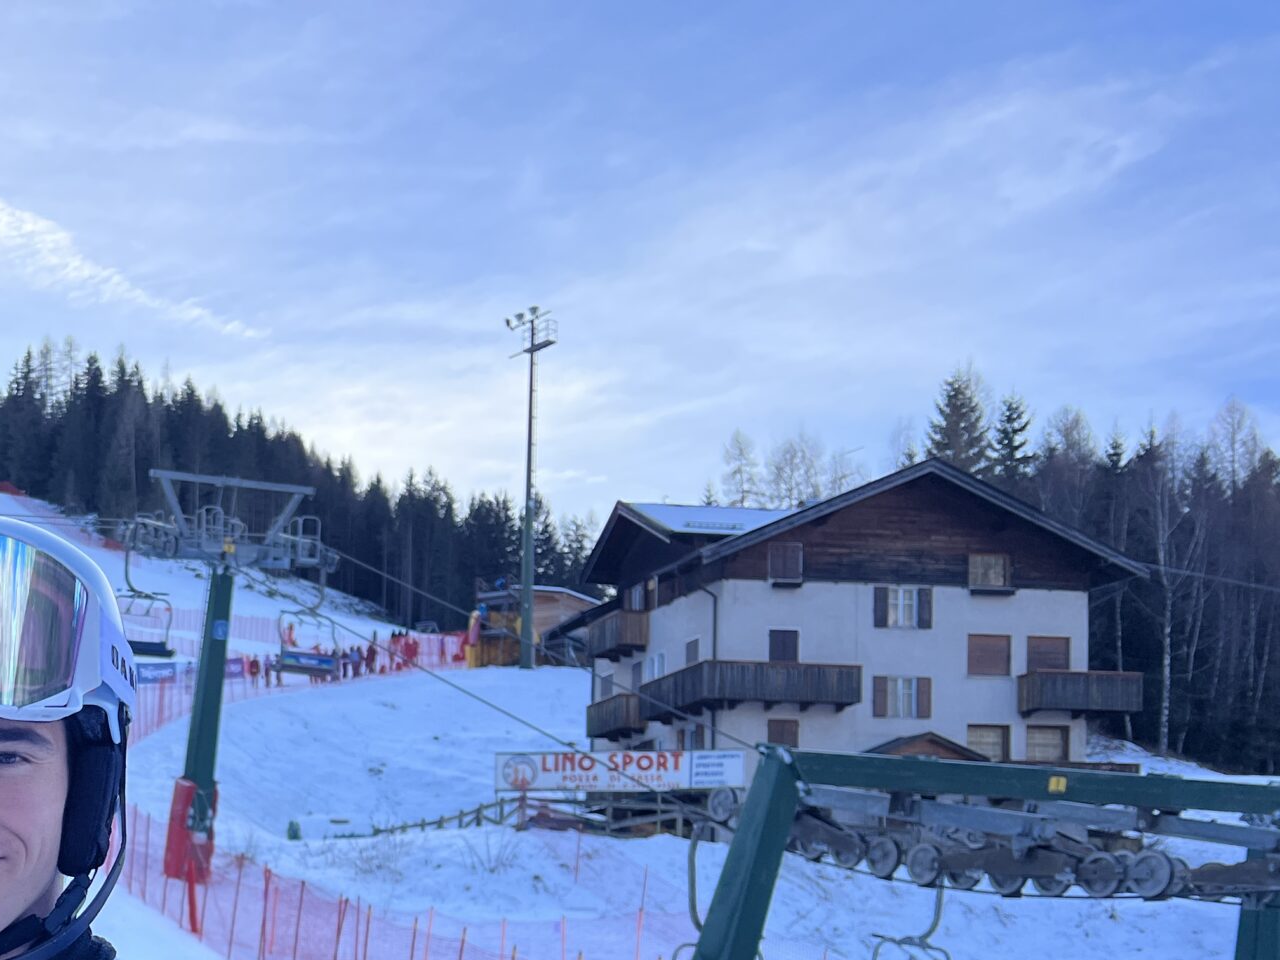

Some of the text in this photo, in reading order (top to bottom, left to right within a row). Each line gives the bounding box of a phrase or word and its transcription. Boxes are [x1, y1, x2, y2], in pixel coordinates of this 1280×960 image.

[111, 644, 137, 693] OAK
[542, 752, 683, 771] LINO SPORT
